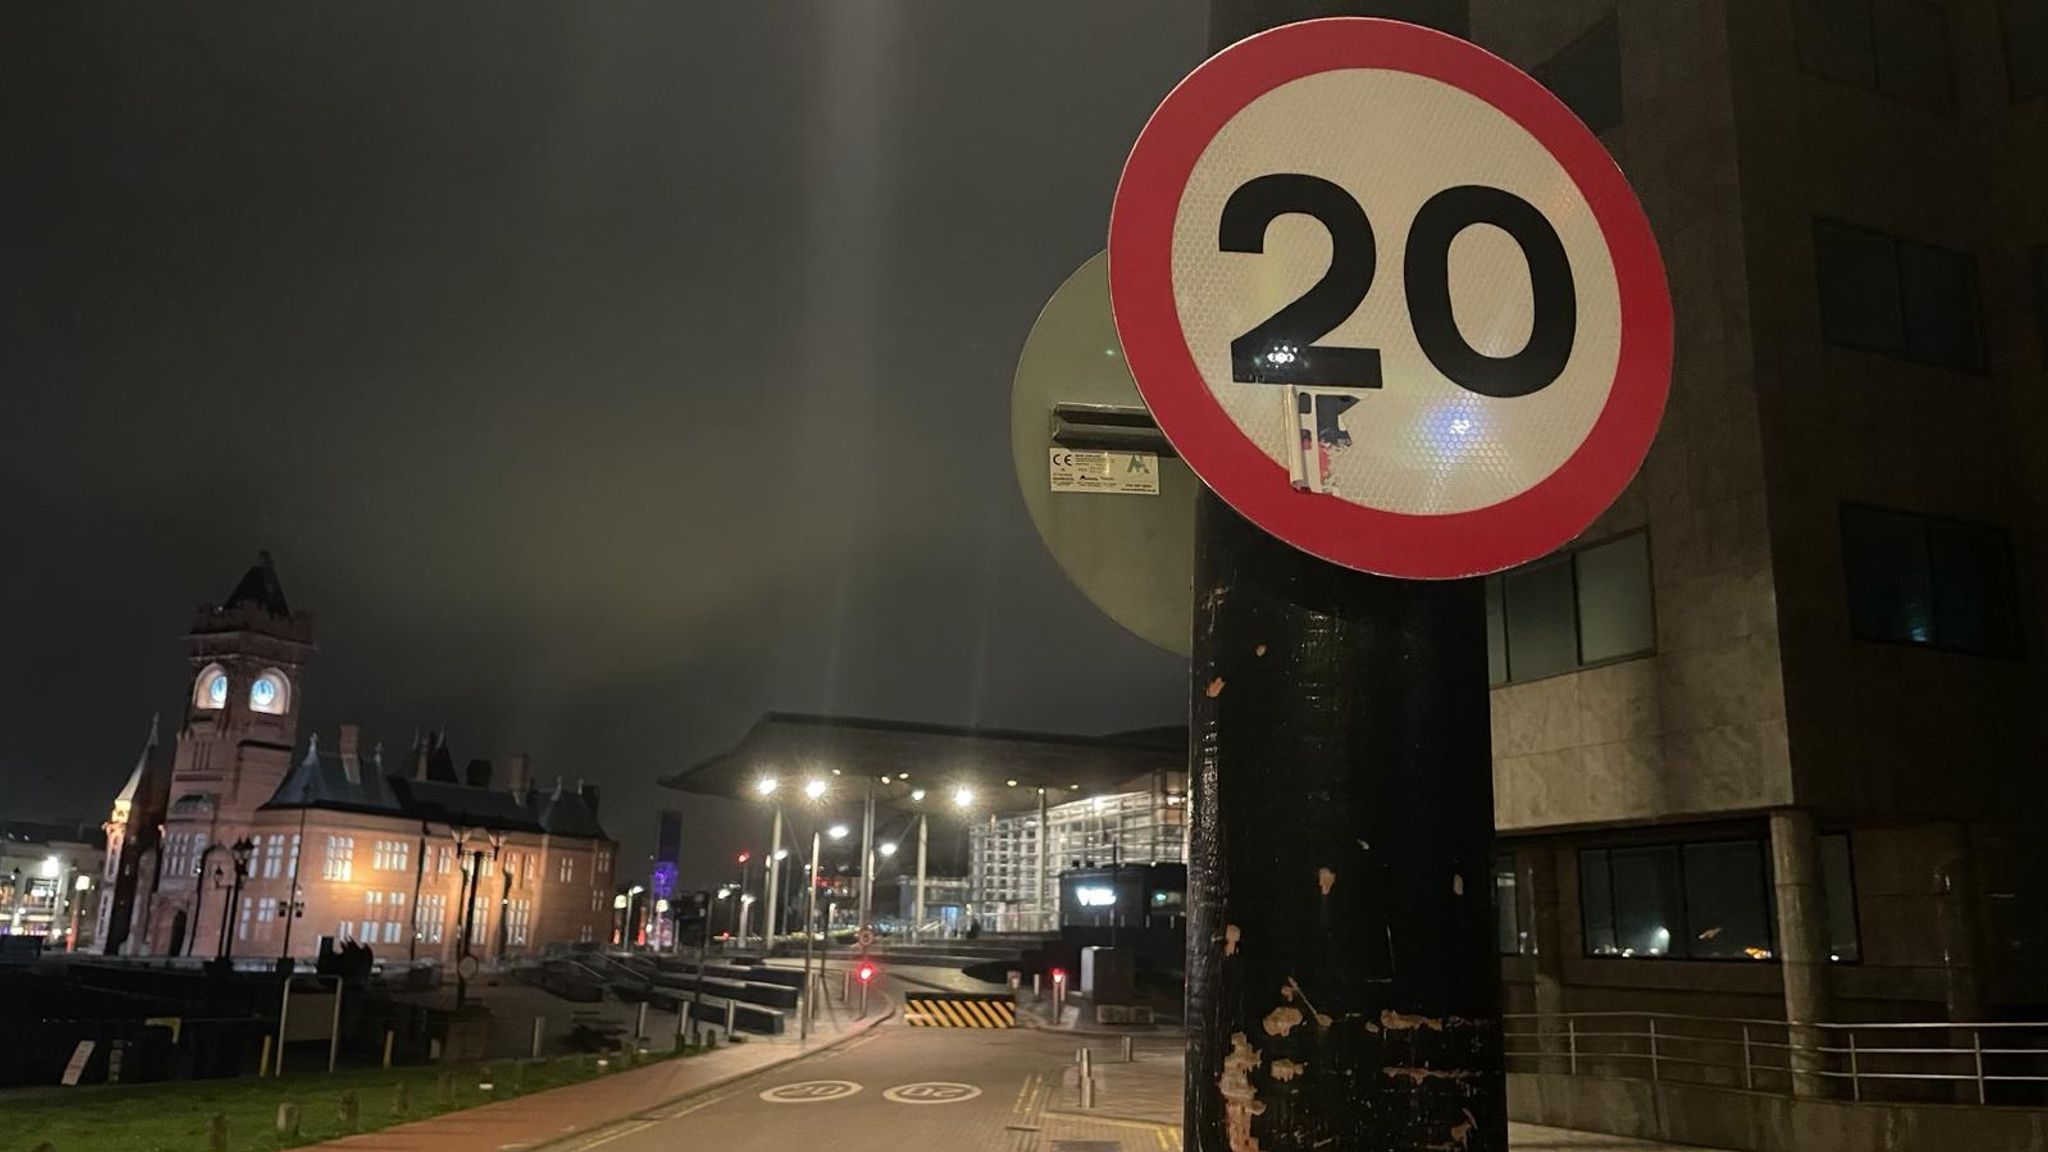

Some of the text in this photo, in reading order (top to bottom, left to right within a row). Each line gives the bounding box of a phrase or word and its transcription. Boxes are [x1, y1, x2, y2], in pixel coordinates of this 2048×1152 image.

[1219, 173, 1577, 398] 20
[1053, 453, 1073, 467] CE
[778, 1085, 845, 1097] 20
[901, 1086, 964, 1097] 20
